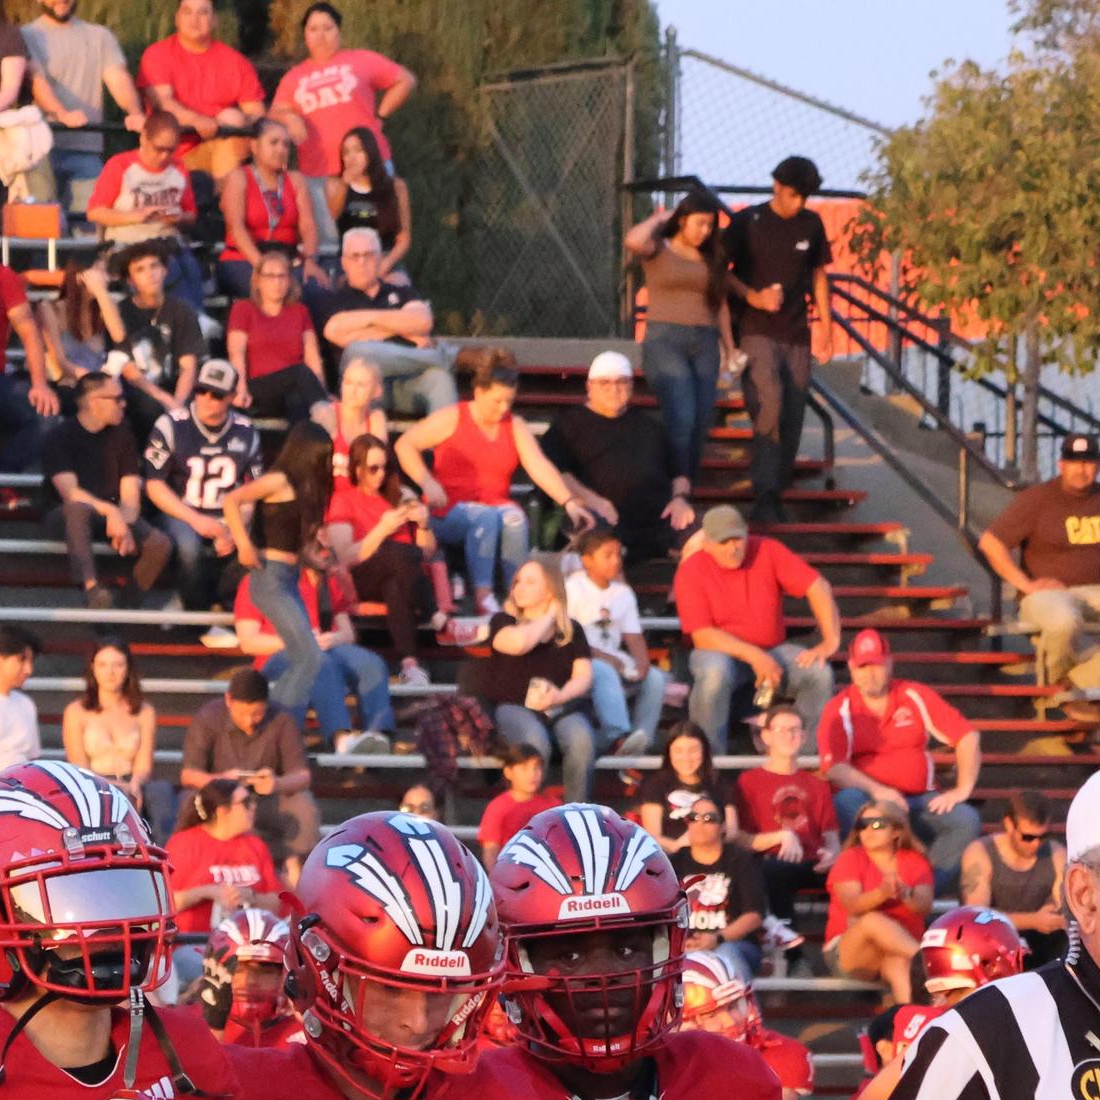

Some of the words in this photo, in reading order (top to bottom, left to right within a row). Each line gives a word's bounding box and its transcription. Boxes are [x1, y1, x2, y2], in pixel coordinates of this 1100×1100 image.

[181, 455, 236, 509] 12
[81, 831, 111, 843] schutt
[567, 896, 621, 912] Riddell
[414, 953, 466, 969] Riddell
